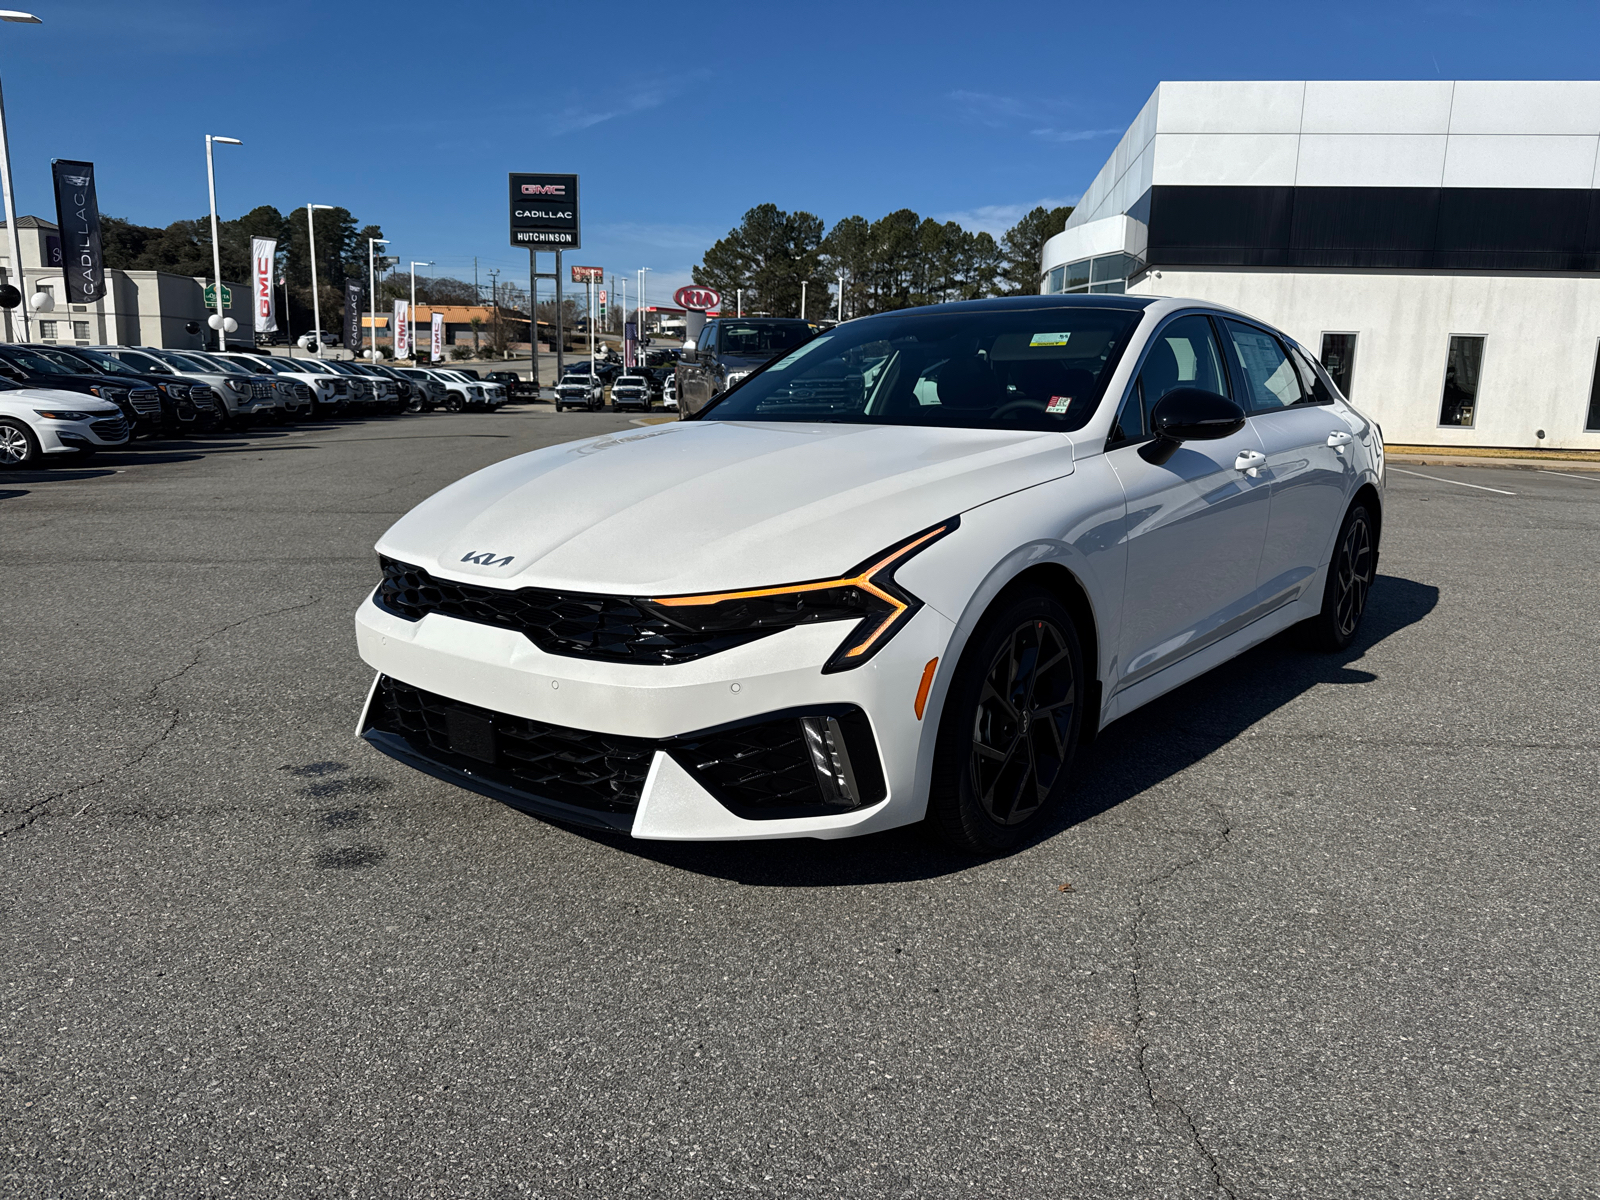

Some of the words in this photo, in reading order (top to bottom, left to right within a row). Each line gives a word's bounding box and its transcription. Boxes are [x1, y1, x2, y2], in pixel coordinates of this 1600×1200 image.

[521, 184, 566, 195] GMC
[515, 210, 573, 219] CADILLAC
[73, 193, 95, 295] CADILLAC
[517, 232, 572, 242] HUTCHINSON
[257, 257, 271, 318] GMC
[683, 290, 715, 307] KIA
[350, 294, 358, 346] CADILLAC
[397, 311, 406, 349] GMC
[433, 322, 441, 354] GMC
[460, 550, 516, 568] KIA
